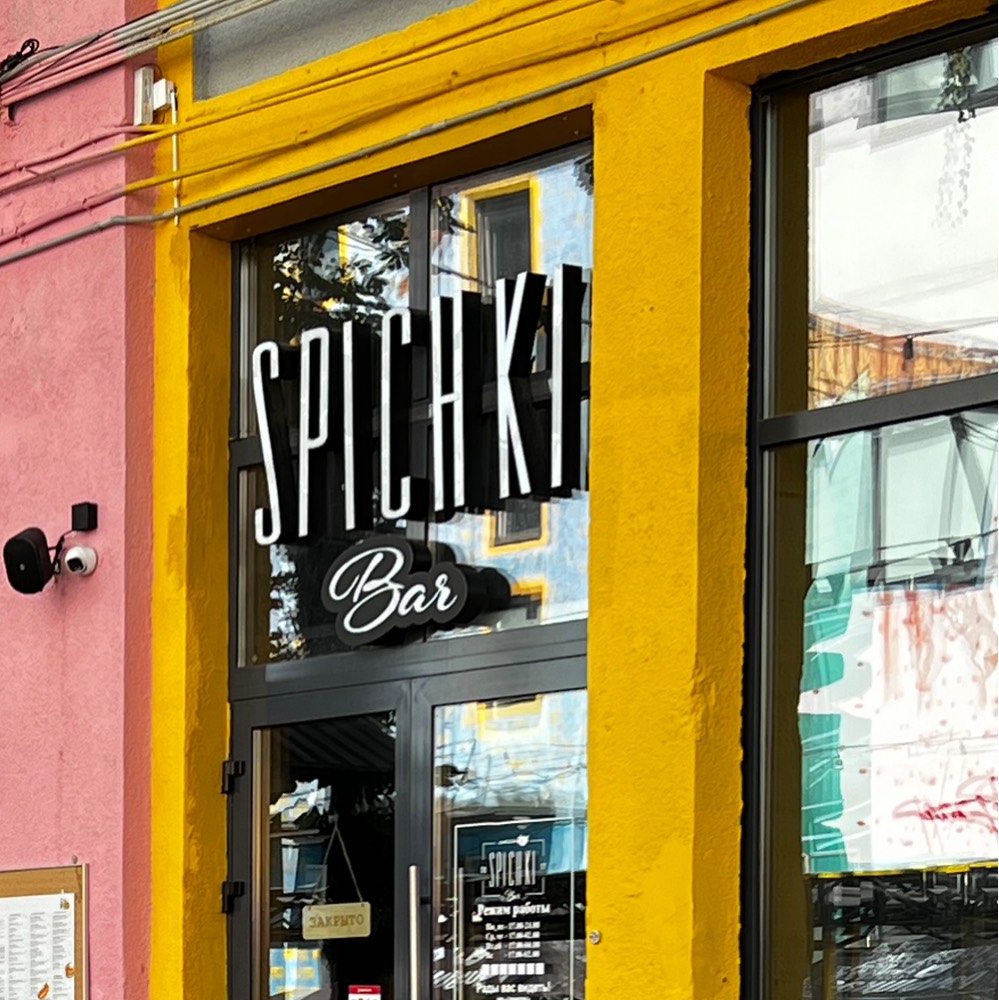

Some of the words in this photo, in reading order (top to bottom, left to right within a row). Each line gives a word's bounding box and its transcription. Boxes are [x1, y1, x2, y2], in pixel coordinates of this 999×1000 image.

[252, 263, 566, 546] SPICHKI
[328, 545, 459, 634] Bar
[309, 914, 365, 930] ЗАКРЫТО
